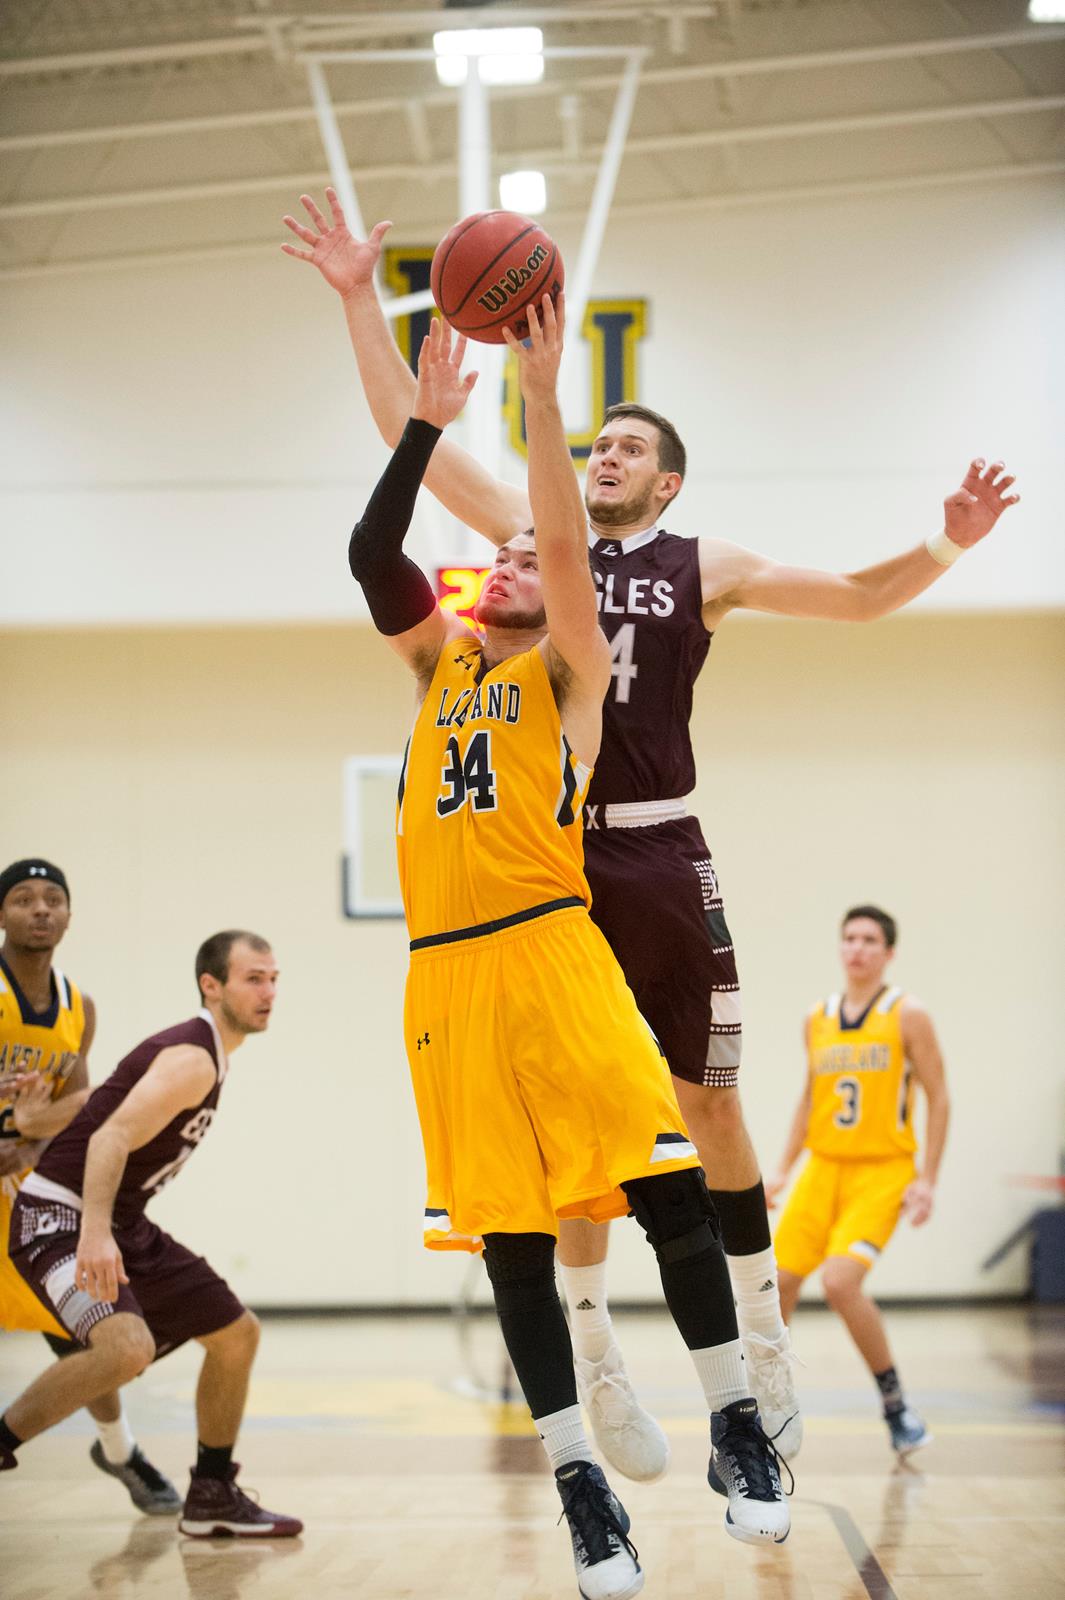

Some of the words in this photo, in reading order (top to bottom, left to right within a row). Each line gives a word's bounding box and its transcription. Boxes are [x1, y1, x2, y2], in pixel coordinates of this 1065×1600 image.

[476, 243, 549, 314] Wilson
[436, 729, 498, 819] 34
[834, 1077, 861, 1130] 3
